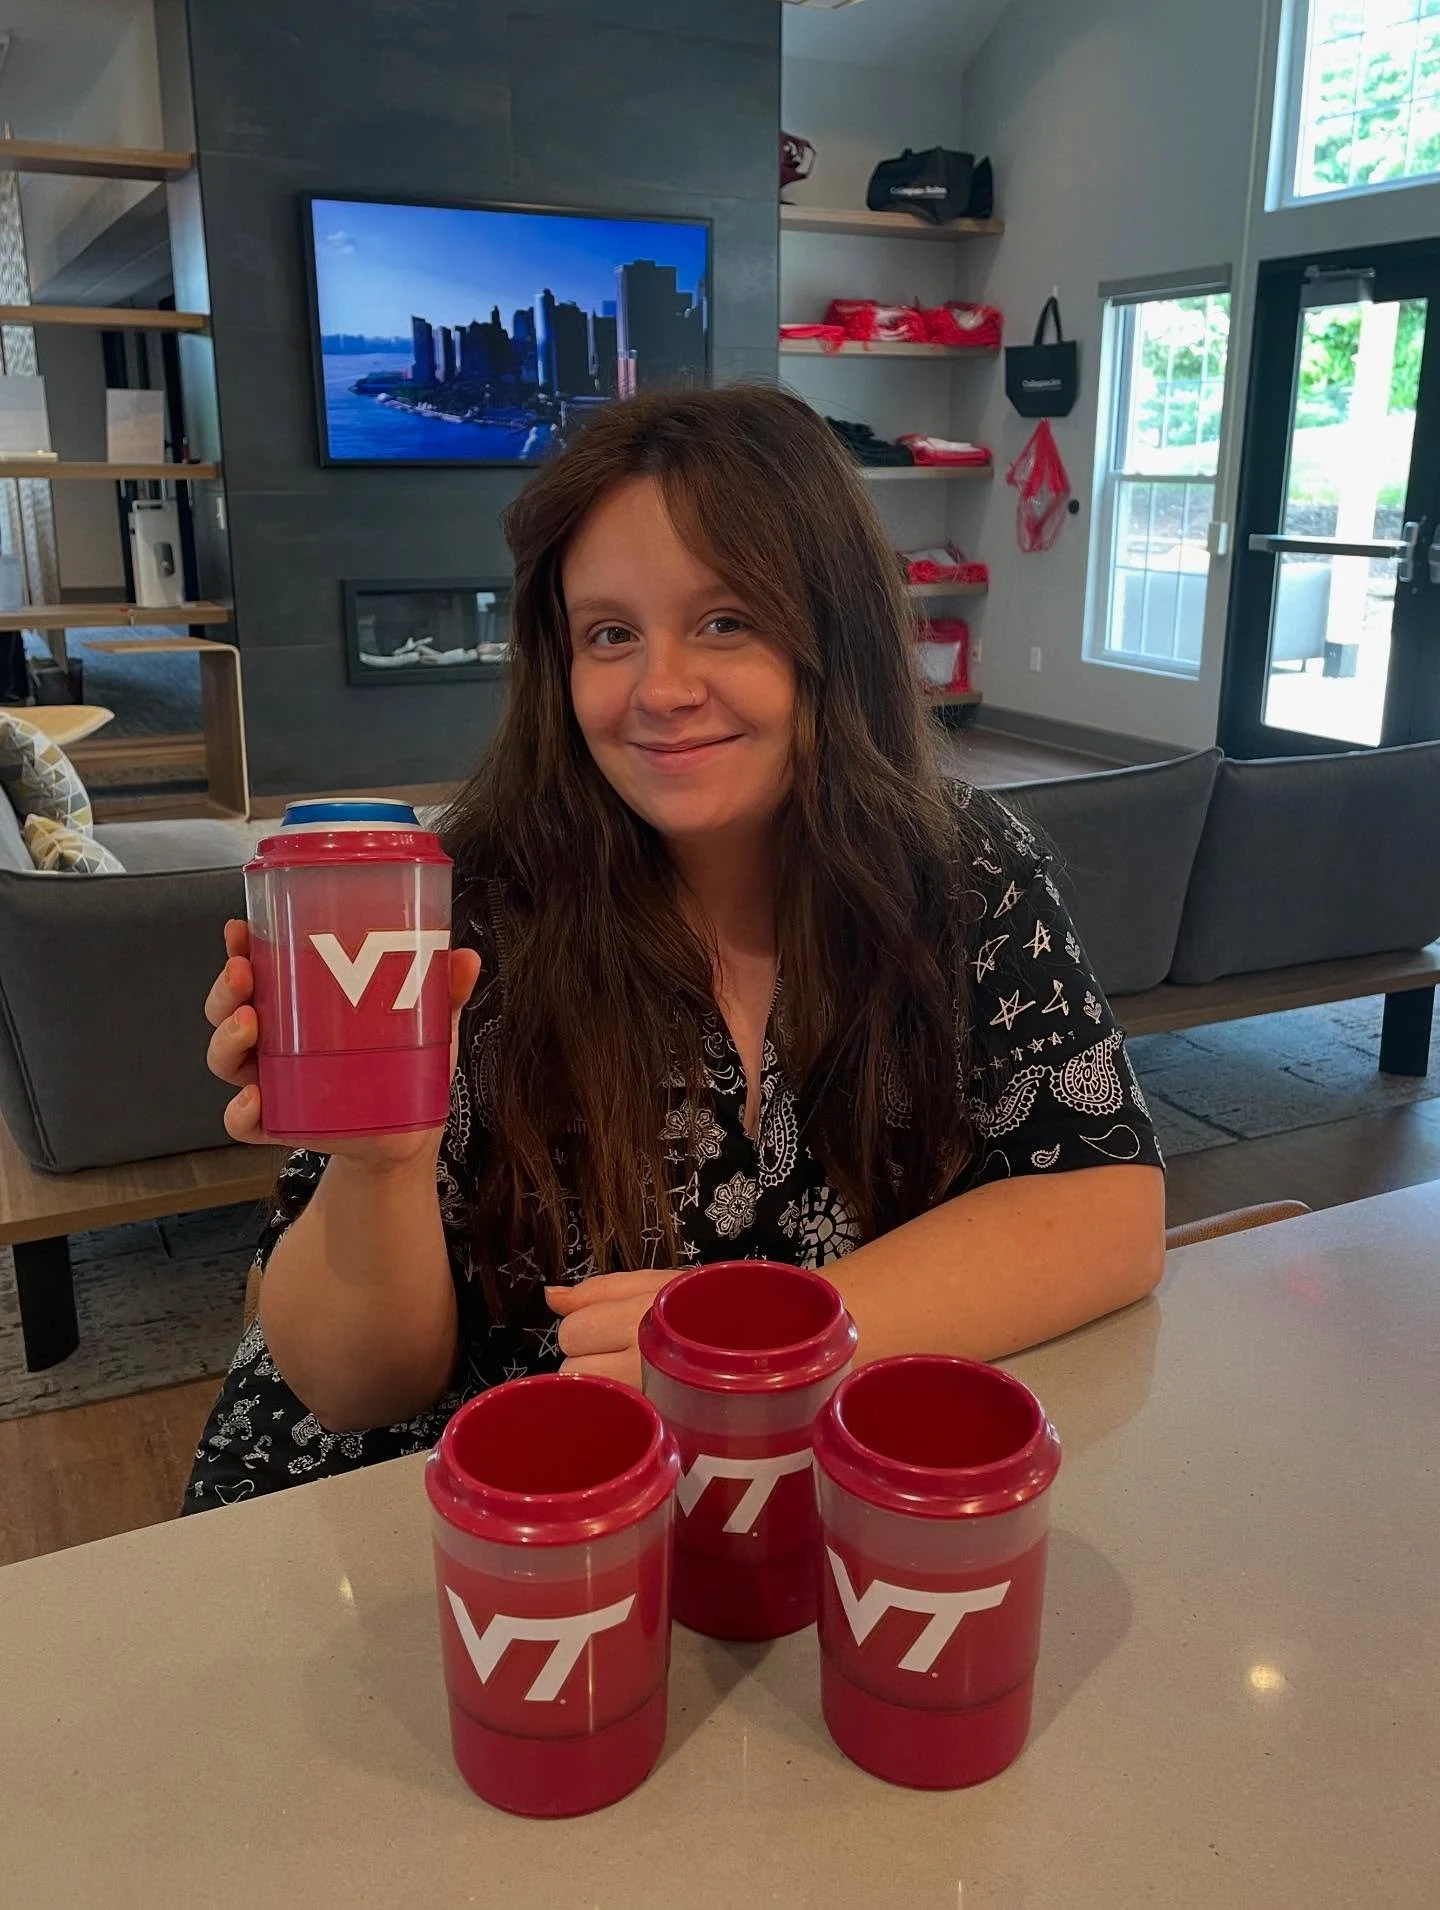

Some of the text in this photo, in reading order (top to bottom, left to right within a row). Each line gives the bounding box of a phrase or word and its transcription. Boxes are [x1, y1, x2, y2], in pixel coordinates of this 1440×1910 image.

[309, 930, 450, 1010] VT
[676, 1447, 814, 1534] VT
[445, 1585, 636, 1702] VT
[826, 1544, 1012, 1673] VT
